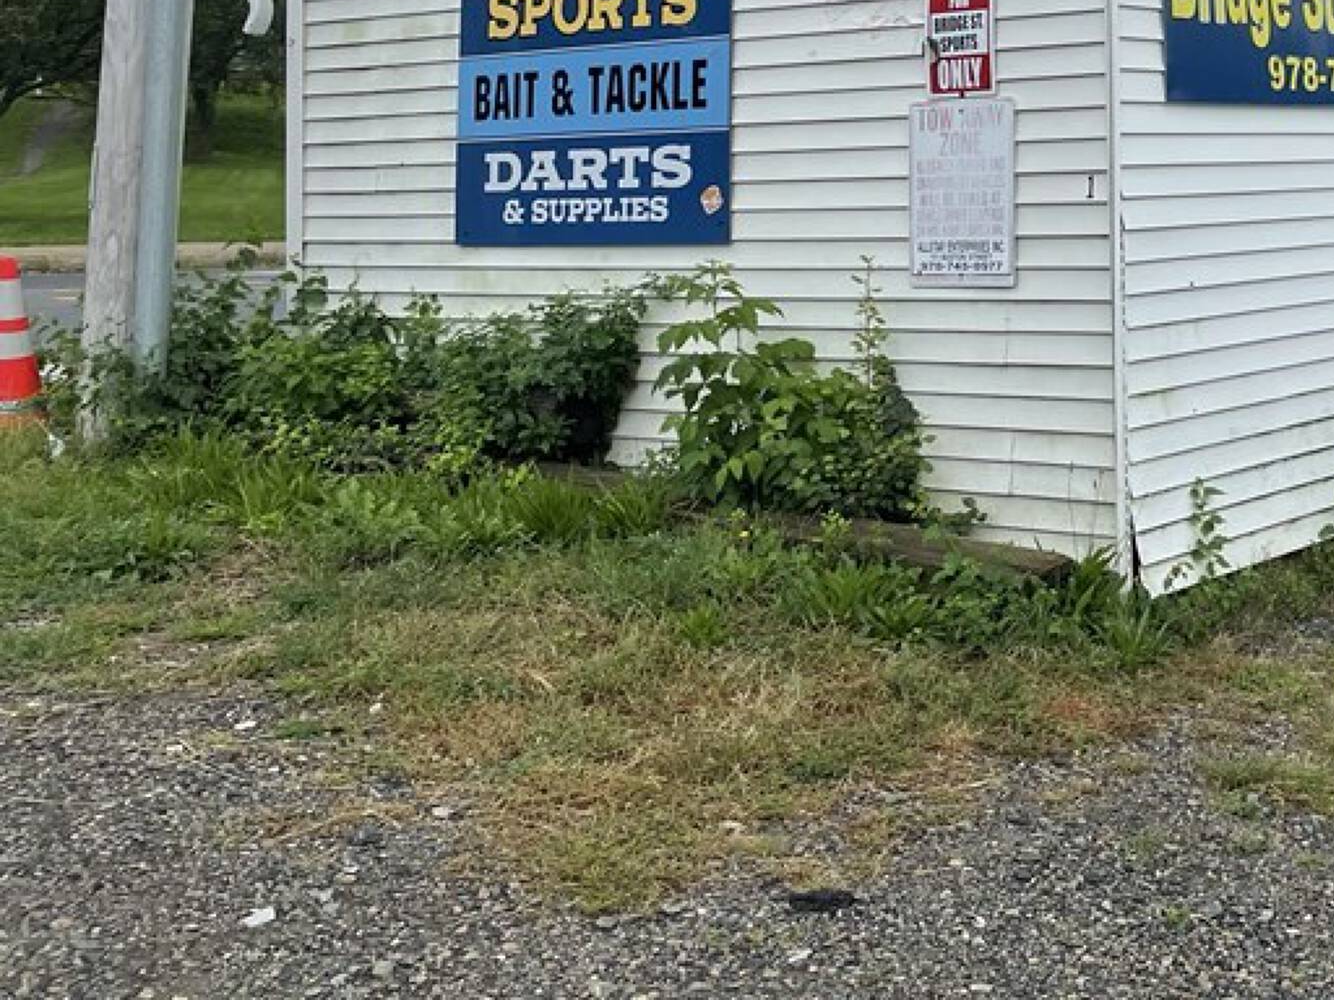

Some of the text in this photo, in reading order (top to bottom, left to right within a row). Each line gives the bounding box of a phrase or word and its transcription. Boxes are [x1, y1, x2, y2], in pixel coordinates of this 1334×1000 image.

[474, 58, 708, 122] BAIT & TACKLE
[937, 56, 984, 90] ONLY
[483, 145, 694, 193] DARTS
[502, 196, 669, 225] & SUPPLIES
